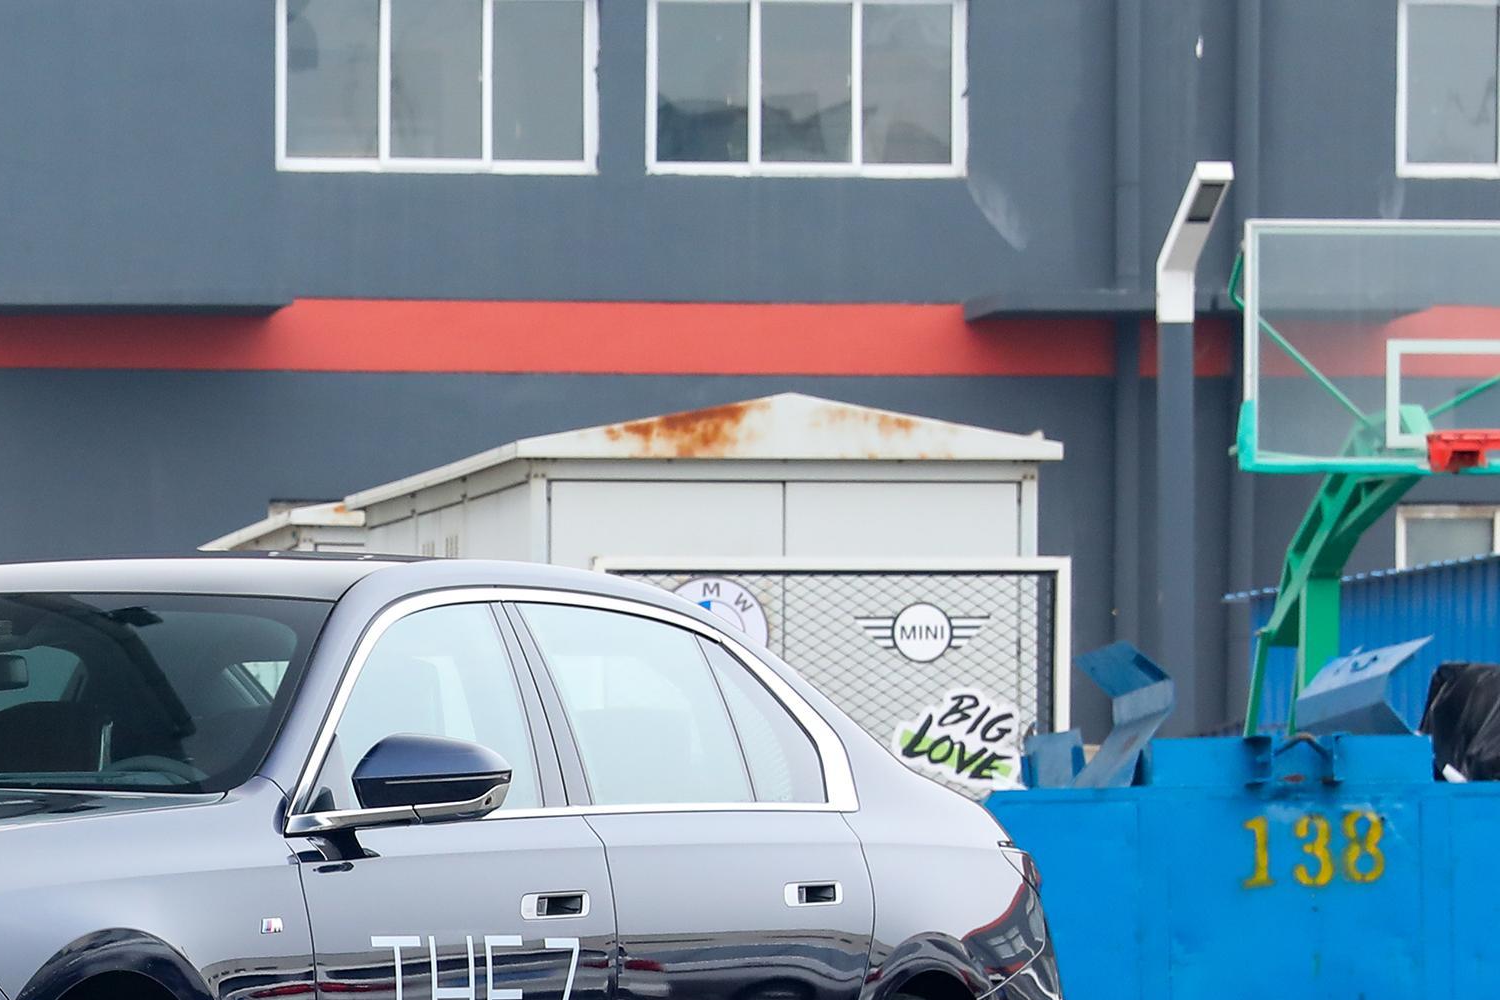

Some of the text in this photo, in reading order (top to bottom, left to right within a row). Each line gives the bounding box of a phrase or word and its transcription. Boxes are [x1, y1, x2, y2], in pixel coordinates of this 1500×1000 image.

[702, 582, 754, 613] MW
[900, 625, 945, 640] MINI
[938, 694, 1014, 743] BIG
[901, 713, 1013, 780] LOVE
[1243, 810, 1385, 888] 138
